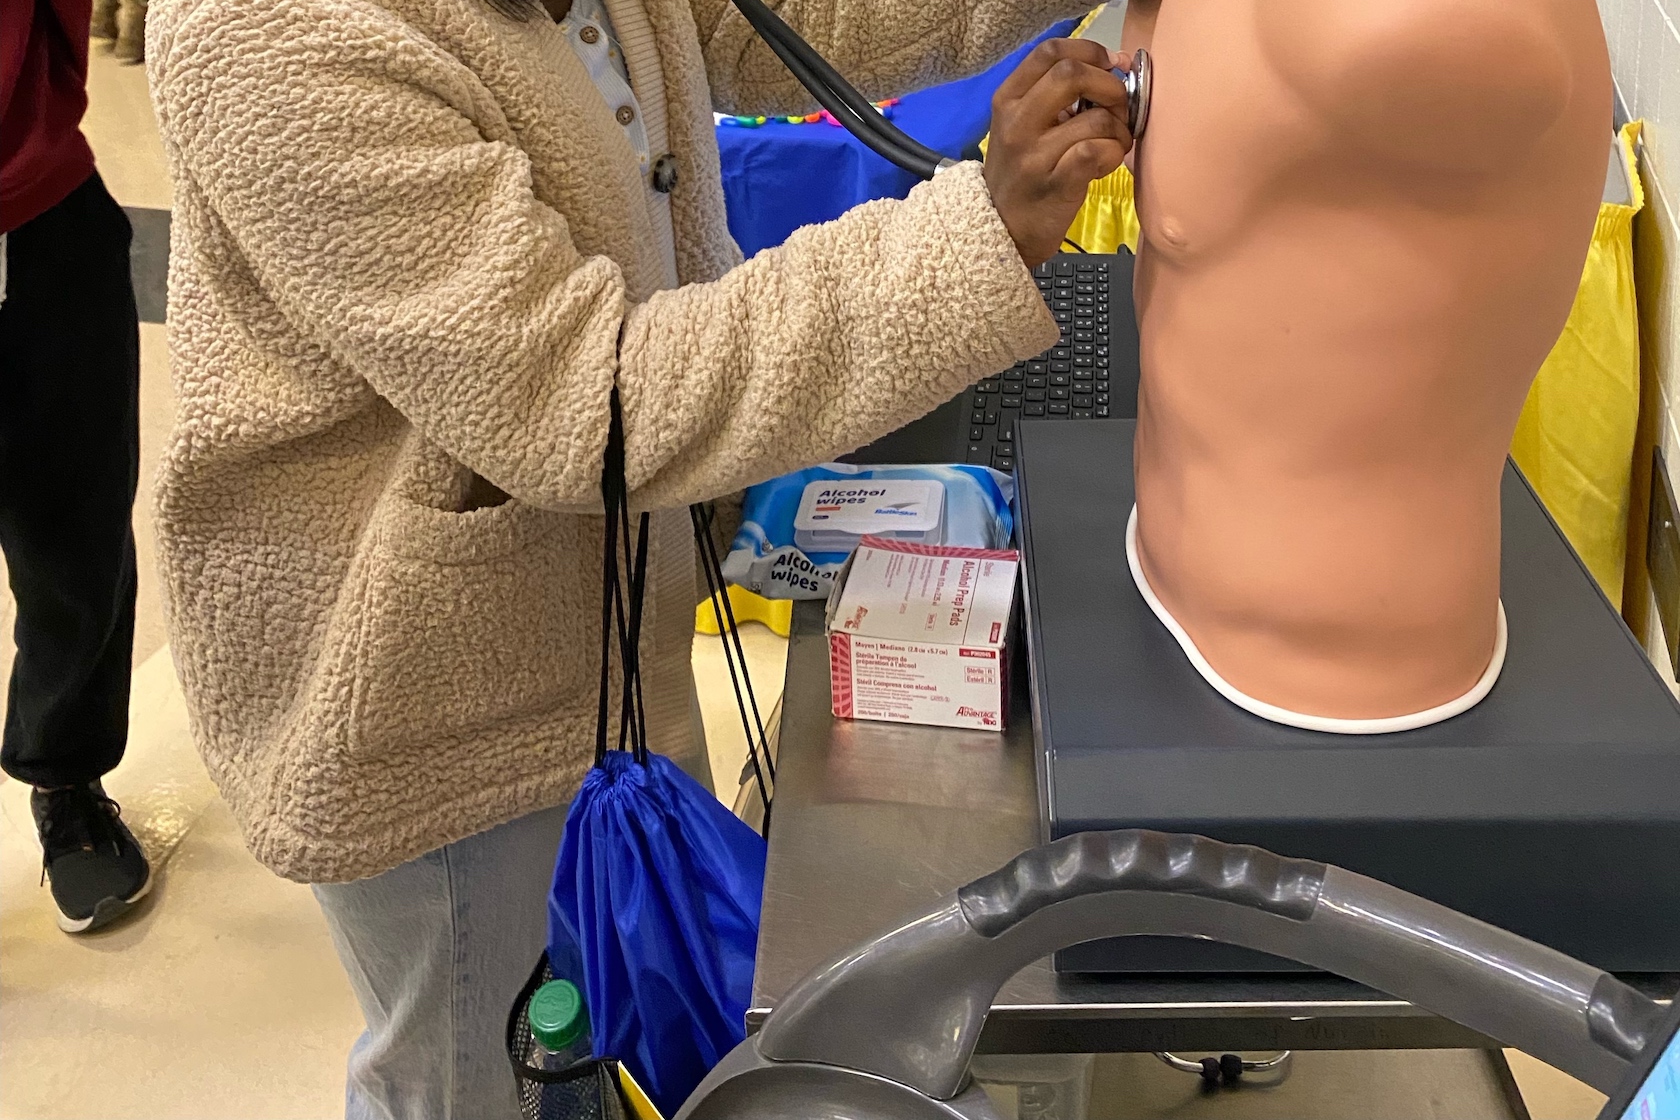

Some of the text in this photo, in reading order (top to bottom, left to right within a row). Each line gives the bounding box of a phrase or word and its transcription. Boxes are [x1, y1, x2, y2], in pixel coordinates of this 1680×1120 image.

[819, 489, 886, 498] Alcohol
[816, 497, 867, 506] wipes
[771, 567, 818, 592] wipes
[949, 560, 975, 627] Alcohol Prep Pads
[855, 641, 875, 649] Moyen
[880, 643, 906, 651] Mediano
